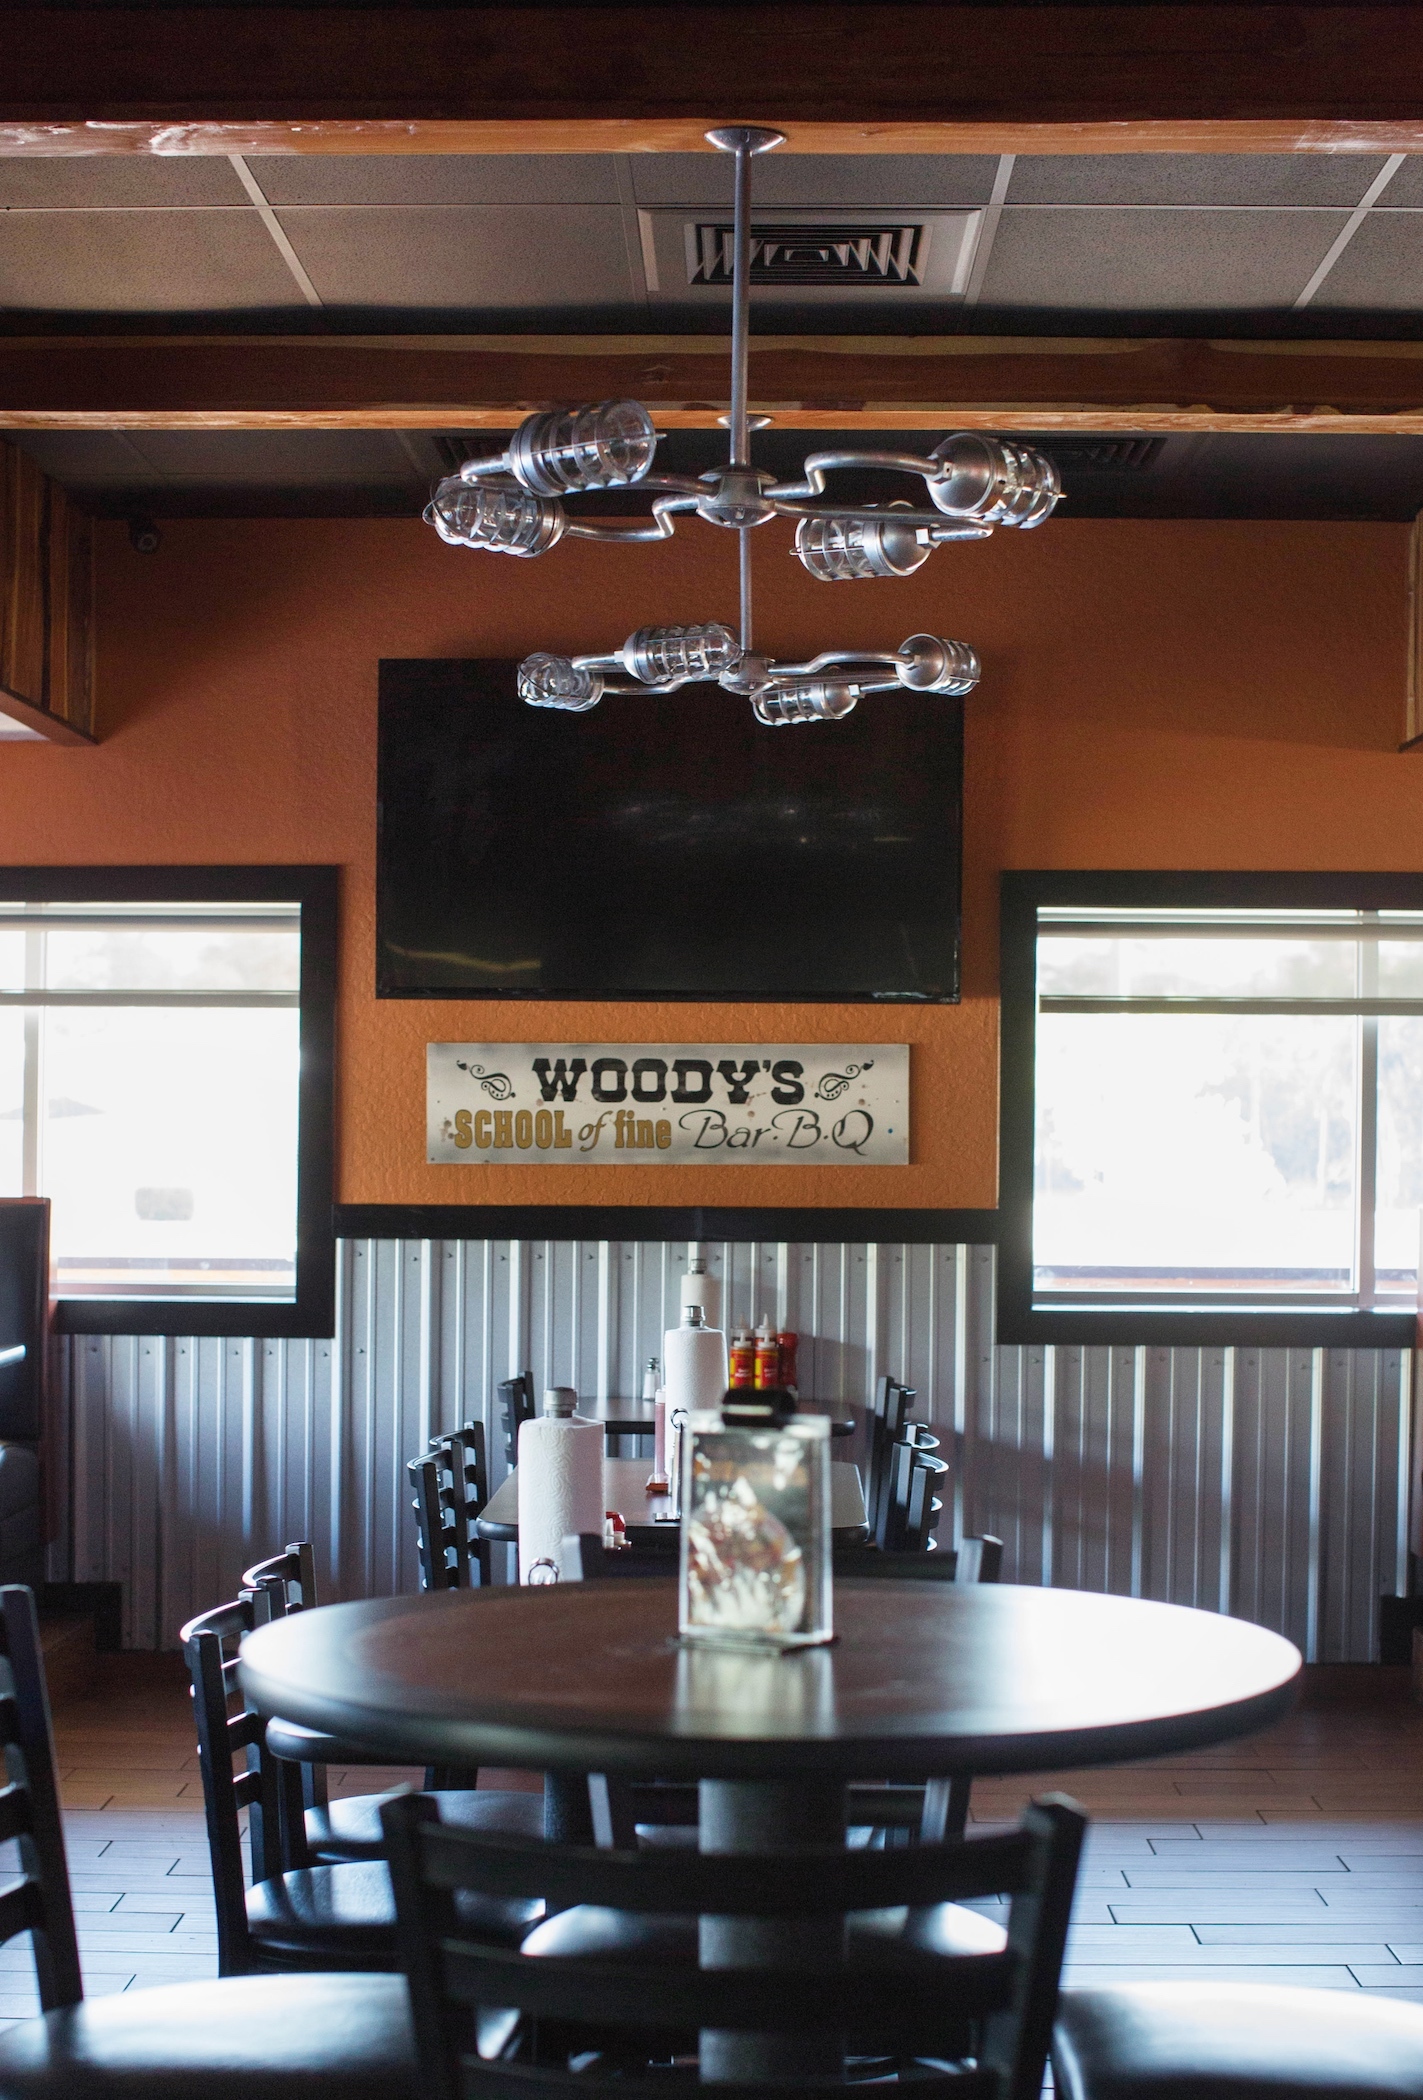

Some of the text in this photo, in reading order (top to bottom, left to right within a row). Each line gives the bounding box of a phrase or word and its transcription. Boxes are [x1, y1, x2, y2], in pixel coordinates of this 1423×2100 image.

[532, 1058, 805, 1105] WOODY'S
[454, 1109, 572, 1149] SCHOOL
[578, 1110, 613, 1152] of
[614, 1110, 671, 1150] fine
